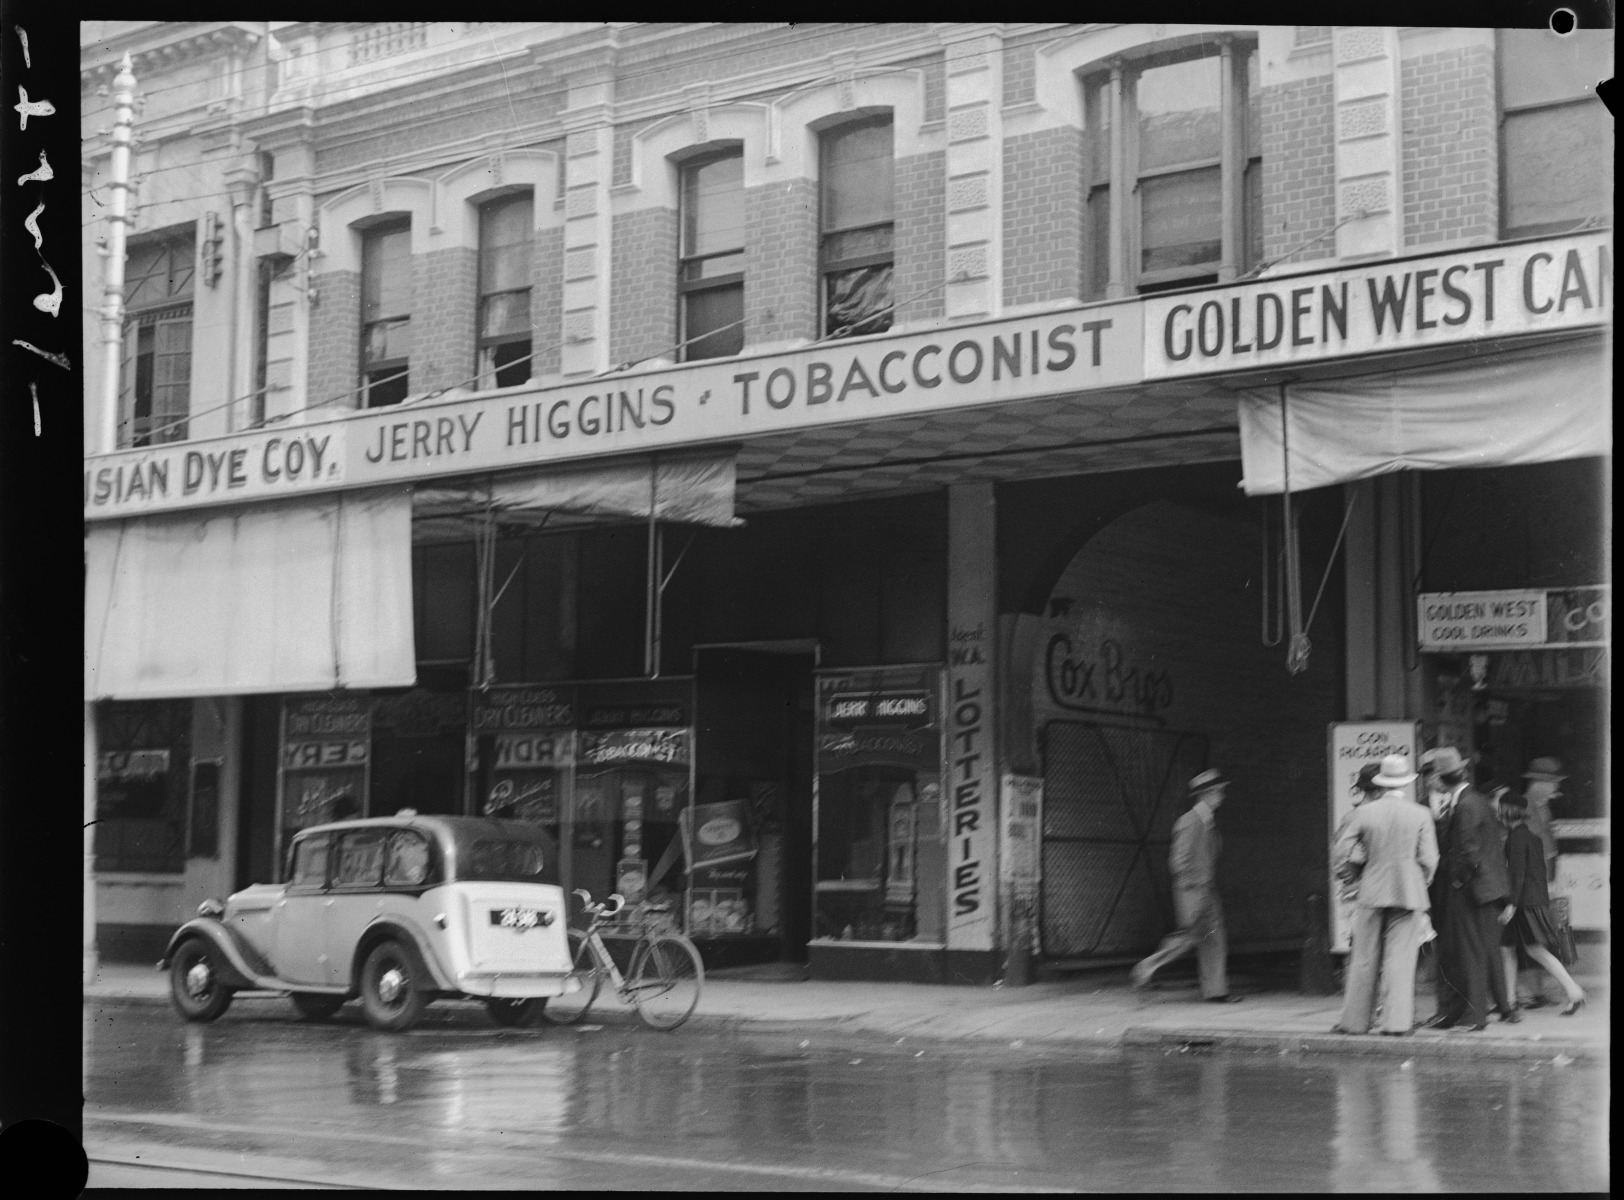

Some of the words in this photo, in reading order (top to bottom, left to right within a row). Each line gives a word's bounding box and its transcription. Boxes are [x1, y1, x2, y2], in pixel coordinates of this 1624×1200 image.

[1164, 281, 1349, 362] GOLDEN
[1367, 260, 1505, 336] WEST
[366, 411, 484, 464] JERRY
[507, 385, 675, 447] HIGGINS
[733, 319, 1113, 415] TOBACCONIST
[183, 448, 248, 496] DYE
[1426, 602, 1487, 622] GOLDEN
[1490, 600, 1539, 617] WEST
[1432, 625, 1469, 641] COOL
[1471, 623, 1529, 640] DRINKS
[954, 677, 982, 918] LOTTERIES
